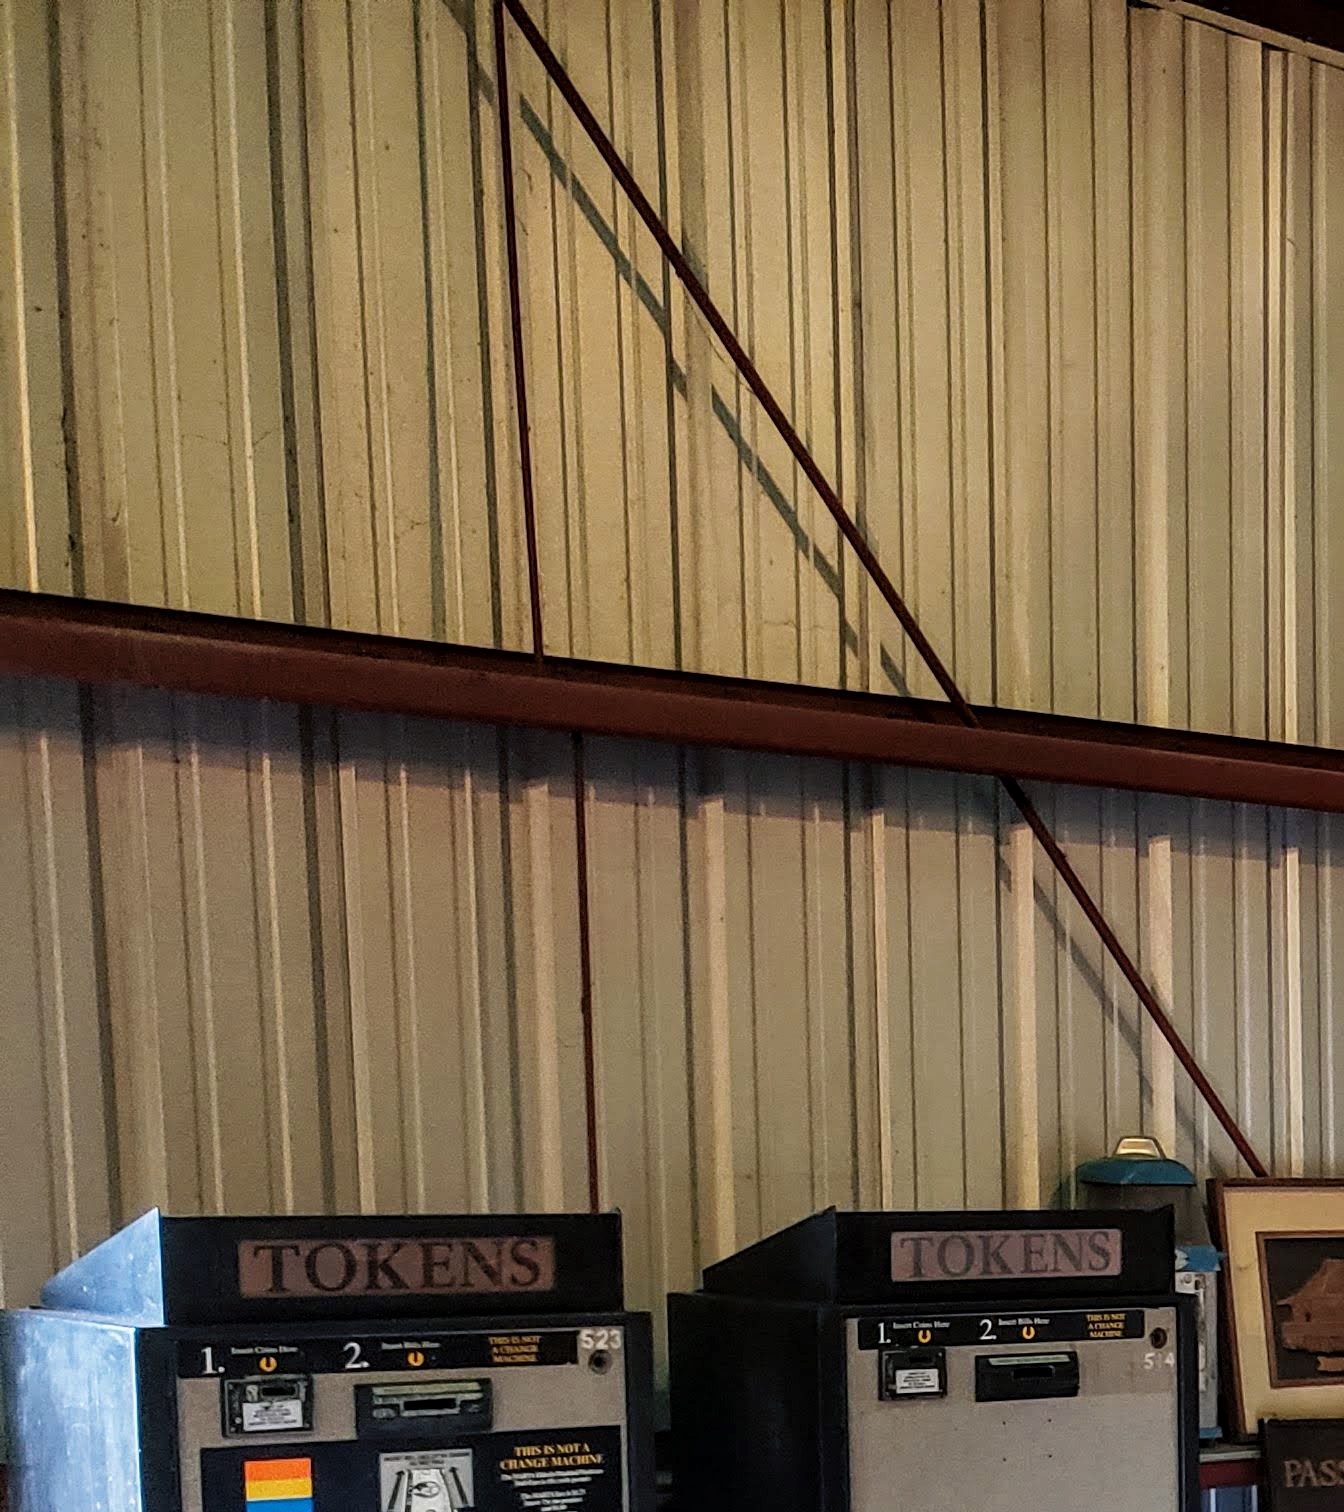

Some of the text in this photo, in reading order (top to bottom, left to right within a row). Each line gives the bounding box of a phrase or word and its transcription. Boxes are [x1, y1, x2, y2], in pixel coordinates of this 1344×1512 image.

[901, 1230, 1112, 1279] TOKENS
[253, 1238, 541, 1293] TOKENS
[580, 1329, 622, 1350] 523
[878, 1322, 891, 1344] 1.
[979, 1319, 997, 1340] 2.
[1090, 1330, 1123, 1338] MACHINE
[488, 1337, 510, 1345] THIS
[511, 1336, 520, 1344] IS
[201, 1347, 225, 1375] 1.
[344, 1342, 370, 1369] 2.
[493, 1355, 538, 1363] MACHINE
[514, 1443, 590, 1456] THIS IS NOT A
[500, 1454, 604, 1470] CHANGE MACHINE
